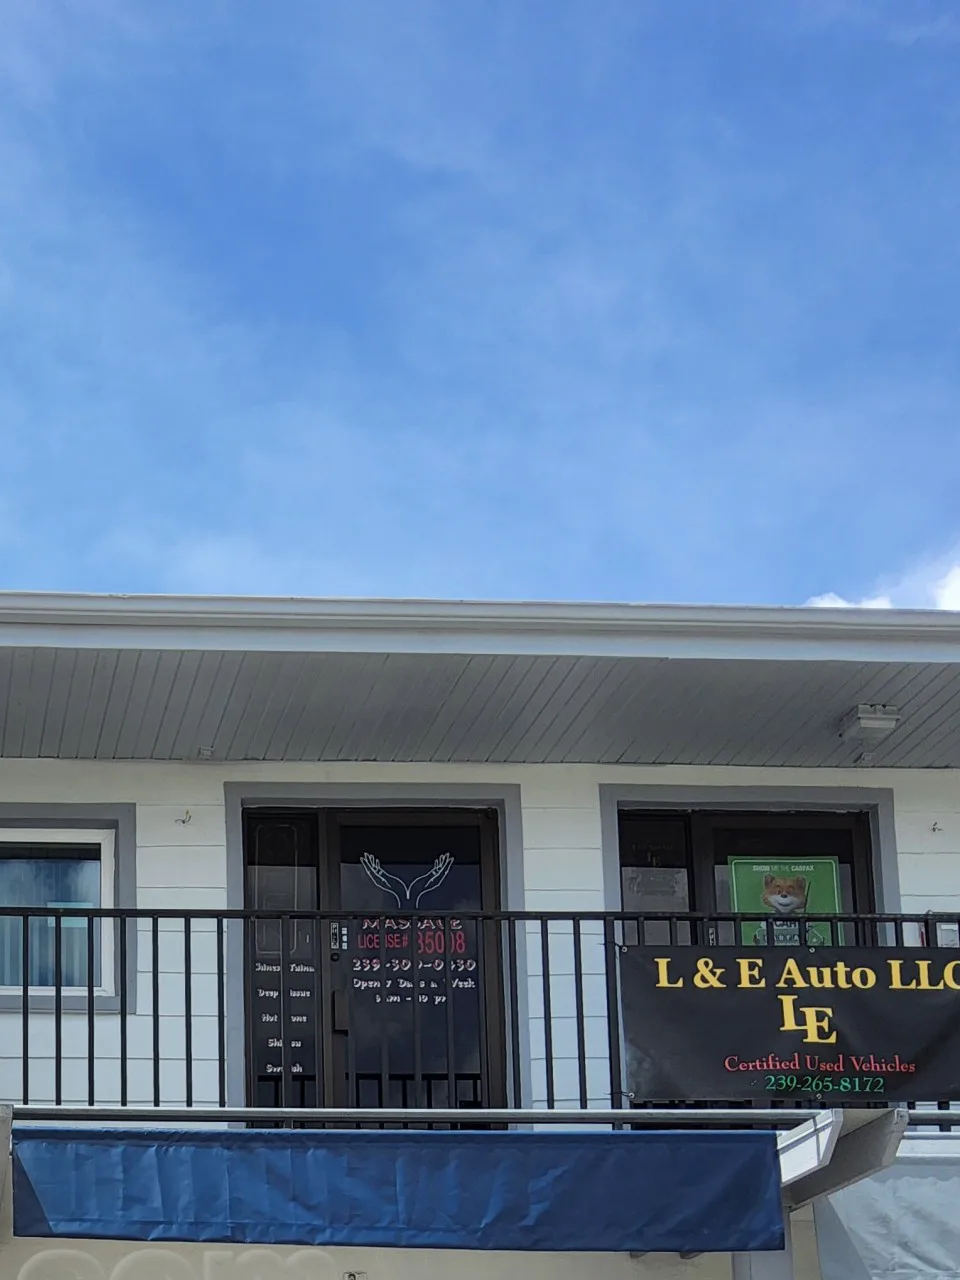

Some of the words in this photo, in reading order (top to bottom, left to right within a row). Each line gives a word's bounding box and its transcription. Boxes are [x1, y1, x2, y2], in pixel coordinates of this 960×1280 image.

[362, 919, 463, 930] MASAE
[357, 933, 409, 949] LICESE#
[654, 958, 684, 989] L
[693, 957, 727, 989] &
[736, 958, 767, 989] E
[775, 958, 877, 989] Auto
[778, 994, 837, 1044] LE
[724, 1053, 800, 1073] Certified
[805, 1054, 845, 1073] Used
[850, 1055, 917, 1073] Vehicles
[764, 1074, 885, 1094] 239-265-8172
